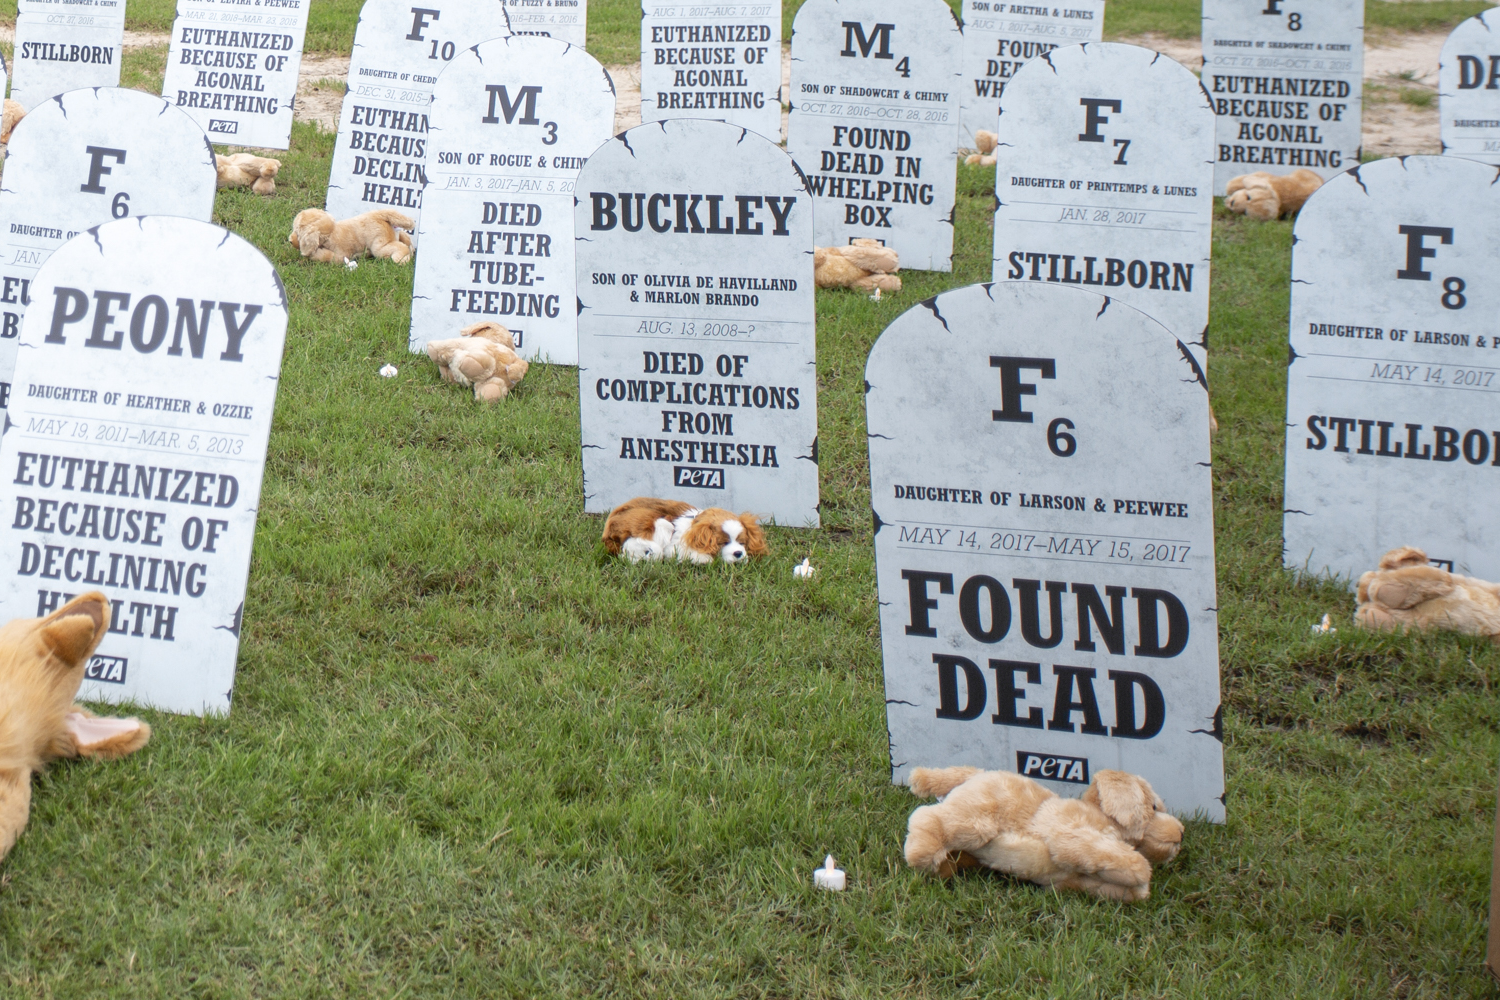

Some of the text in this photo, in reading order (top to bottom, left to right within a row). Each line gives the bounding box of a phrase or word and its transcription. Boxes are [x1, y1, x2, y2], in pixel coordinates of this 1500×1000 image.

[651, 25, 771, 43] EUTHANIZED
[22, 42, 113, 64] STILLBORN
[654, 48, 768, 65] BECAUSE OF
[674, 70, 747, 87] AGONAL
[1212, 75, 1350, 98] EUTHANIZED
[657, 92, 765, 109] BREATHING
[801, 84, 948, 102] SON OF SHADOWCAT & CHIMY
[1216, 98, 1346, 121] BECAUSE OF
[833, 126, 911, 151] FOUND
[1238, 123, 1322, 144] AGONAL
[821, 151, 921, 178] DEAD IN
[1218, 145, 1342, 168] BREATHING
[806, 175, 934, 205] WHELPING
[1011, 177, 1197, 196] DAUGHTER OF PRINTEMPS & LUNES
[482, 202, 541, 227] DIED
[590, 192, 796, 236] BUCKLEY
[845, 204, 892, 228] BOX
[467, 231, 551, 258] AFTER
[470, 261, 544, 286] TUBE-
[592, 273, 797, 291] SON OF OLIVIA DE HAVILLAND
[1008, 251, 1194, 292] STILLBORN
[450, 289, 560, 318] FEEDING
[630, 291, 759, 306] & MARLON BRANDO
[45, 286, 263, 362] PEONY
[637, 321, 674, 334] AUG.
[681, 323, 697, 337] 13,
[1309, 323, 1383, 340] DAUGHTER
[1390, 330, 1408, 342] OF
[1414, 331, 1469, 346] LARSON
[1476, 336, 1486, 348] &
[643, 351, 748, 378] DIED OF
[1371, 363, 1495, 387] MAY 14, 2017
[27, 384, 97, 403] DAUGHTER
[103, 392, 121, 406] OF
[126, 394, 191, 414] HEATHER
[196, 402, 206, 414] &
[213, 403, 253, 420] OZZIE
[596, 378, 800, 410] COMPLICATIONS
[26, 418, 67, 435] MAY
[70, 422, 89, 440] 19,
[187, 434, 200, 453] 5,
[206, 436, 243, 455] 2013
[662, 411, 733, 436] FROM
[620, 437, 779, 468] ANESTHESIA
[1307, 415, 1500, 467] STILLBO
[13, 452, 239, 509] EUTHANIZED
[894, 485, 1188, 518] DAUGHTER OF LARSON & PEEWEE
[12, 496, 228, 553] BECAUSE OF
[898, 525, 950, 545] MAY
[957, 530, 982, 550] 14,
[1108, 541, 1134, 562] 15,
[1143, 544, 1191, 563] 2017
[17, 542, 207, 598] DECLINING
[37, 590, 179, 641] HLTH
[901, 569, 1189, 658] FOUND
[932, 653, 1165, 740] DEAD
